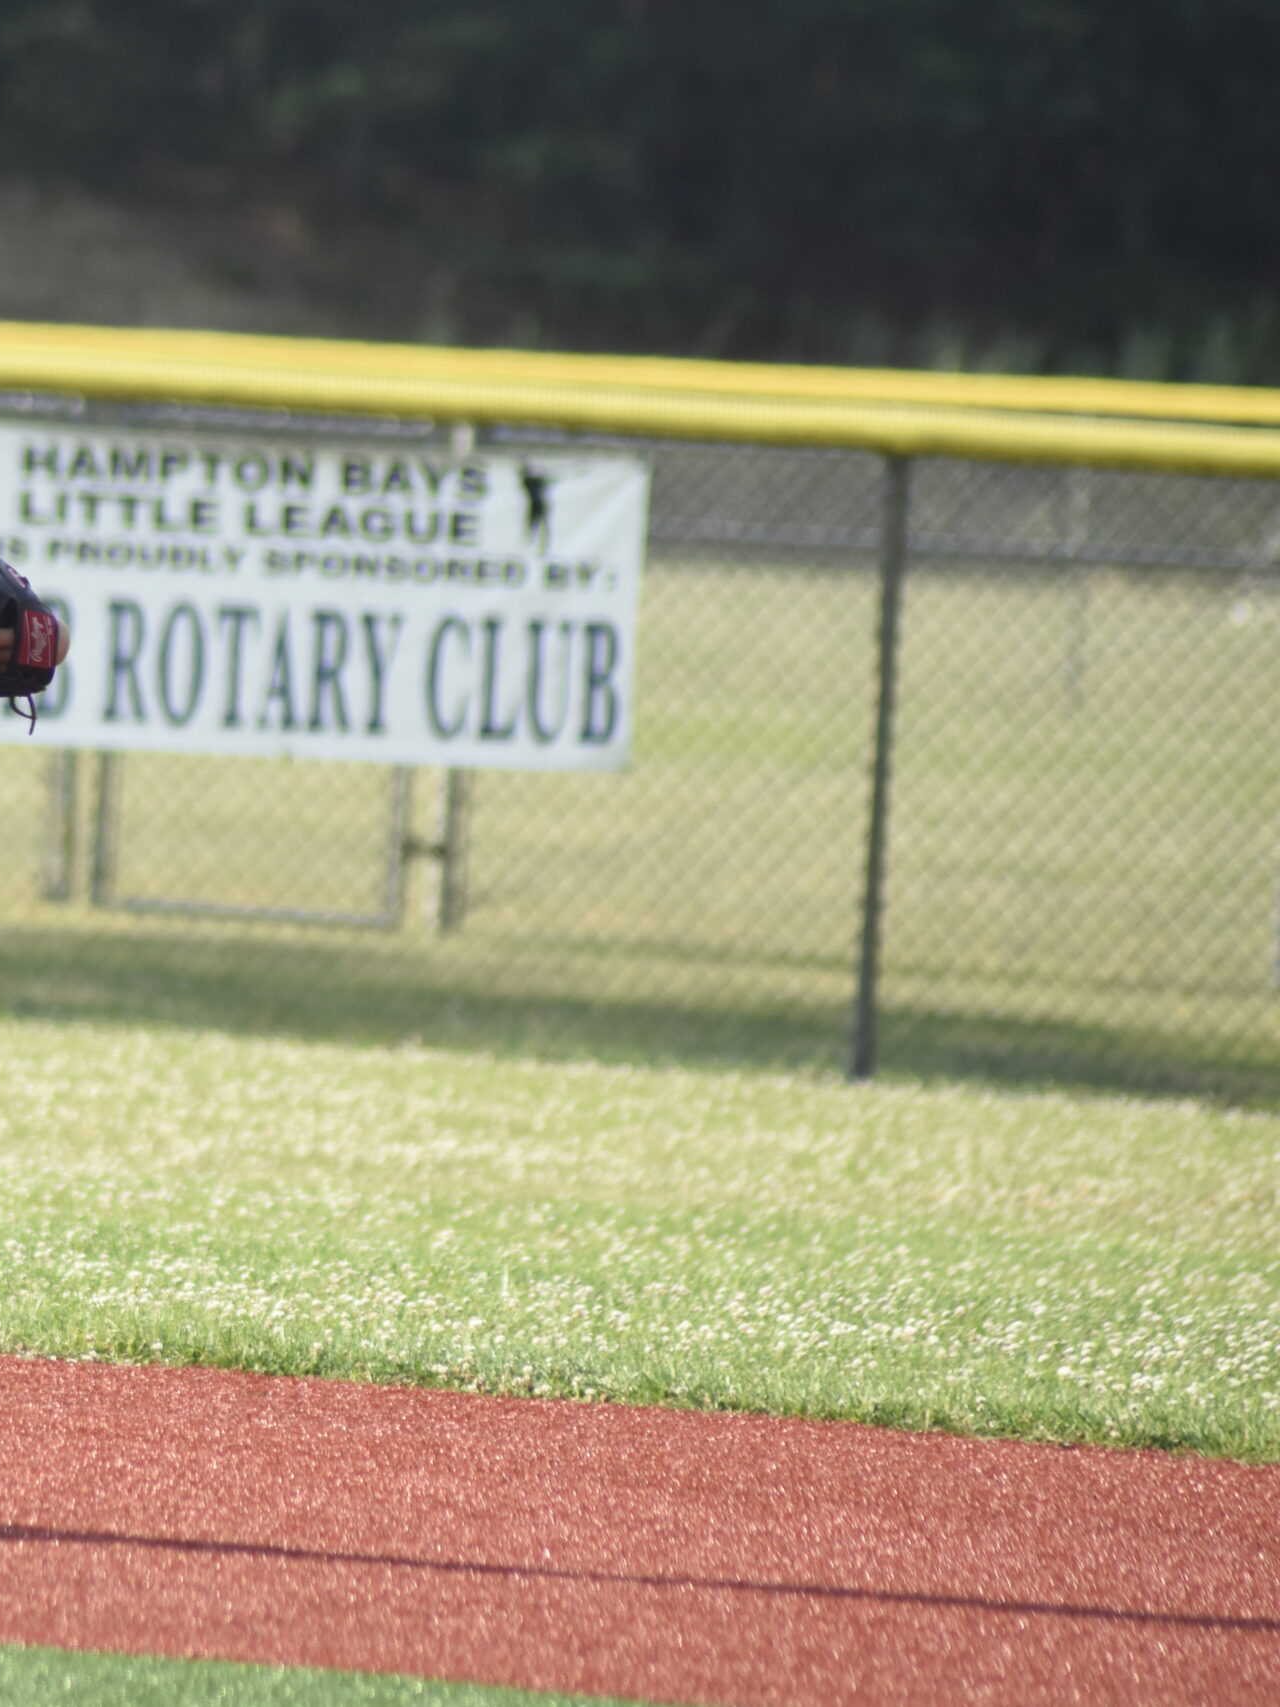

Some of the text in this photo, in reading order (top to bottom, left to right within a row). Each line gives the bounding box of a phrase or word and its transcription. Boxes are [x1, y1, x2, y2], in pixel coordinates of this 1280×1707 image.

[23, 446, 487, 499] HAMPTON BAYS
[21, 491, 477, 546] LITTLE LEAGUE
[48, 540, 244, 574] PROUDLY
[263, 550, 526, 587] SPONSORED
[544, 563, 615, 591] BY:
[105, 601, 401, 734] ROTARY
[428, 615, 618, 744] CLUB
